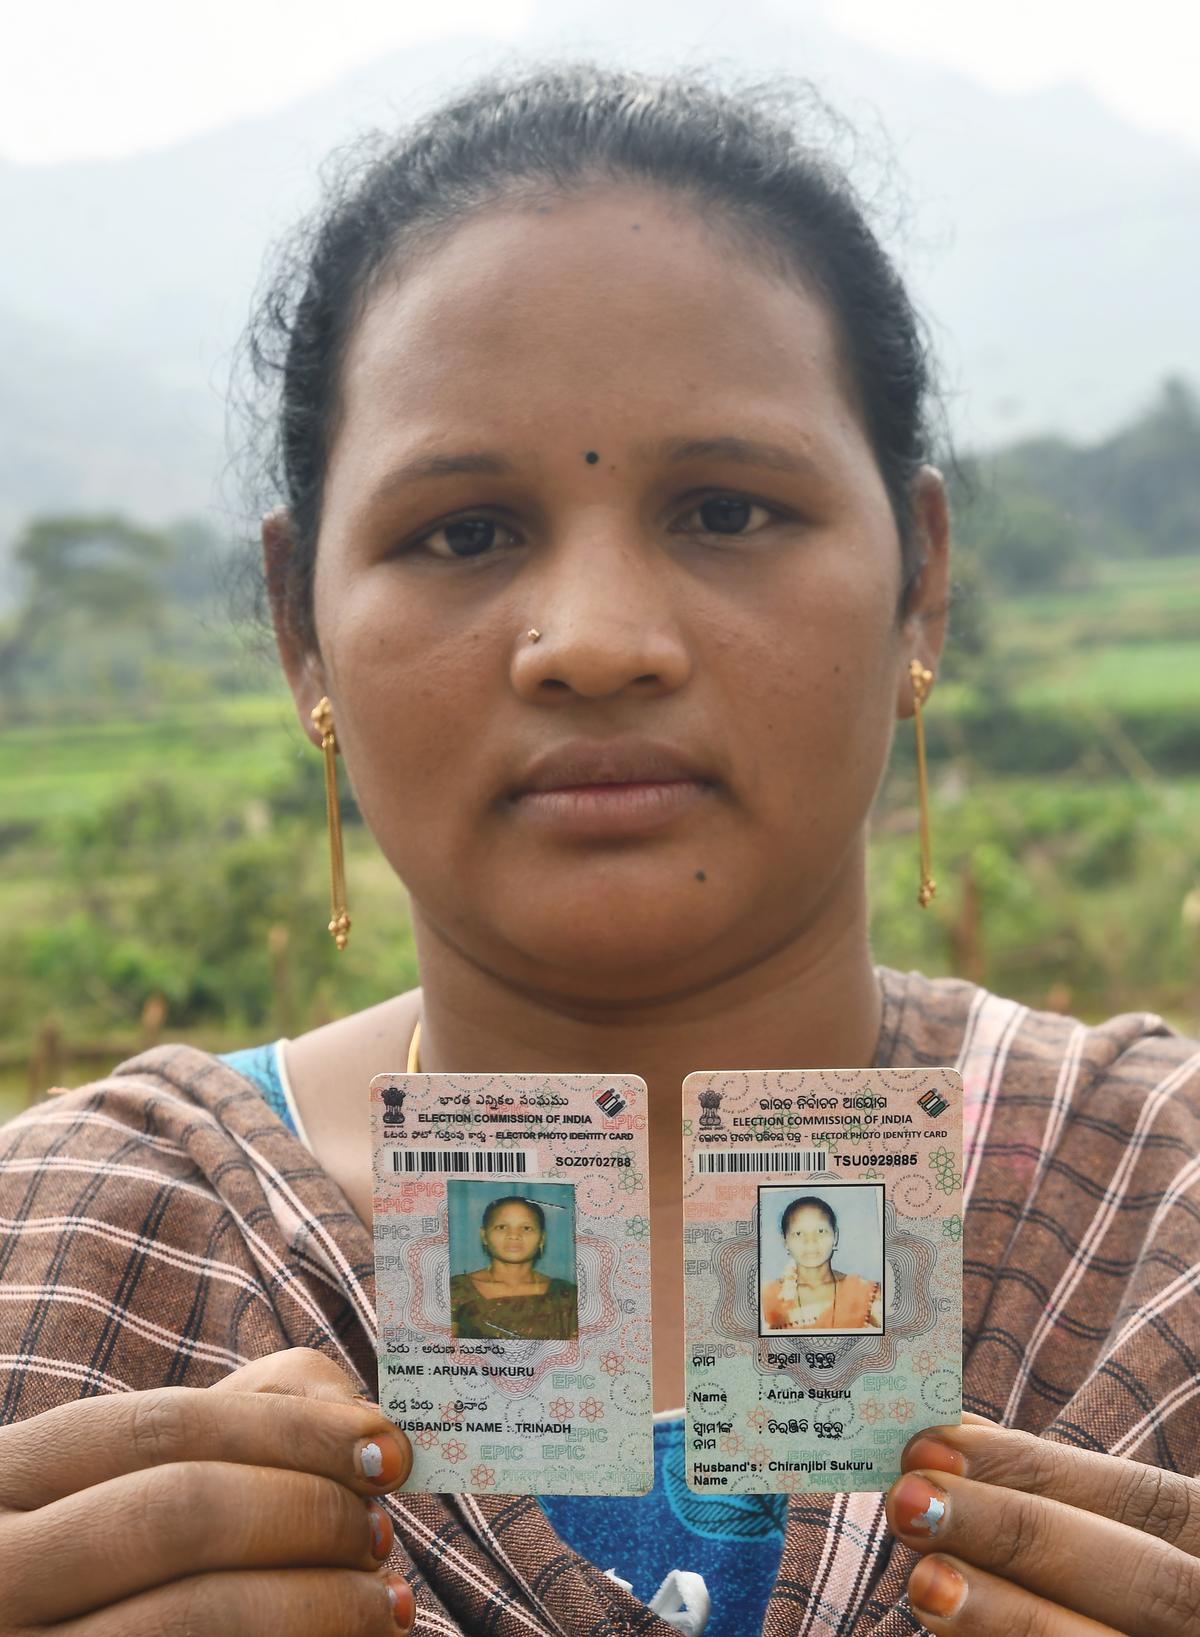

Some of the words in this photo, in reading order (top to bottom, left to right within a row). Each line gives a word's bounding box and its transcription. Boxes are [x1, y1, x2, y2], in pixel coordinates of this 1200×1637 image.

[439, 1094, 471, 1106] భారత
[476, 1094, 515, 1110] ఎన్నికల
[759, 1098, 793, 1110] ଭାରତ
[418, 1114, 471, 1123] ELECTION
[473, 1114, 543, 1124] COMMISSION
[545, 1115, 560, 1124] OF
[563, 1115, 593, 1124] INDIA
[733, 1117, 785, 1127] ELECTION
[787, 1115, 861, 1126] COMMISSION
[864, 1115, 879, 1124] OF
[881, 1114, 913, 1124] INDIA
[496, 1131, 537, 1140] ELECTOR
[537, 1132, 568, 1140] PHOTO
[569, 1132, 607, 1140] IDENTITY
[609, 1133, 634, 1141] CARD
[811, 1132, 848, 1140] ELECTOR
[850, 1131, 880, 1140] PHOTO
[883, 1131, 922, 1140] IDENTITY
[923, 1130, 948, 1138] CARD
[555, 1156, 632, 1168] SOZ0702788
[834, 1154, 918, 1167] TSU0929885
[692, 1356, 716, 1368] ନାମ
[387, 1366, 424, 1376] NAME
[481, 1367, 535, 1377] SUKURU
[693, 1392, 728, 1403] Name
[767, 1389, 805, 1400] Aruna
[808, 1388, 852, 1400] Sukuru
[466, 1422, 503, 1433] NAME
[515, 1422, 571, 1434] TRINADH
[693, 1438, 717, 1450] ନାମ
[768, 1461, 827, 1473] Chiranjibi
[830, 1461, 874, 1471] Sukuru
[693, 1476, 728, 1486] Name
